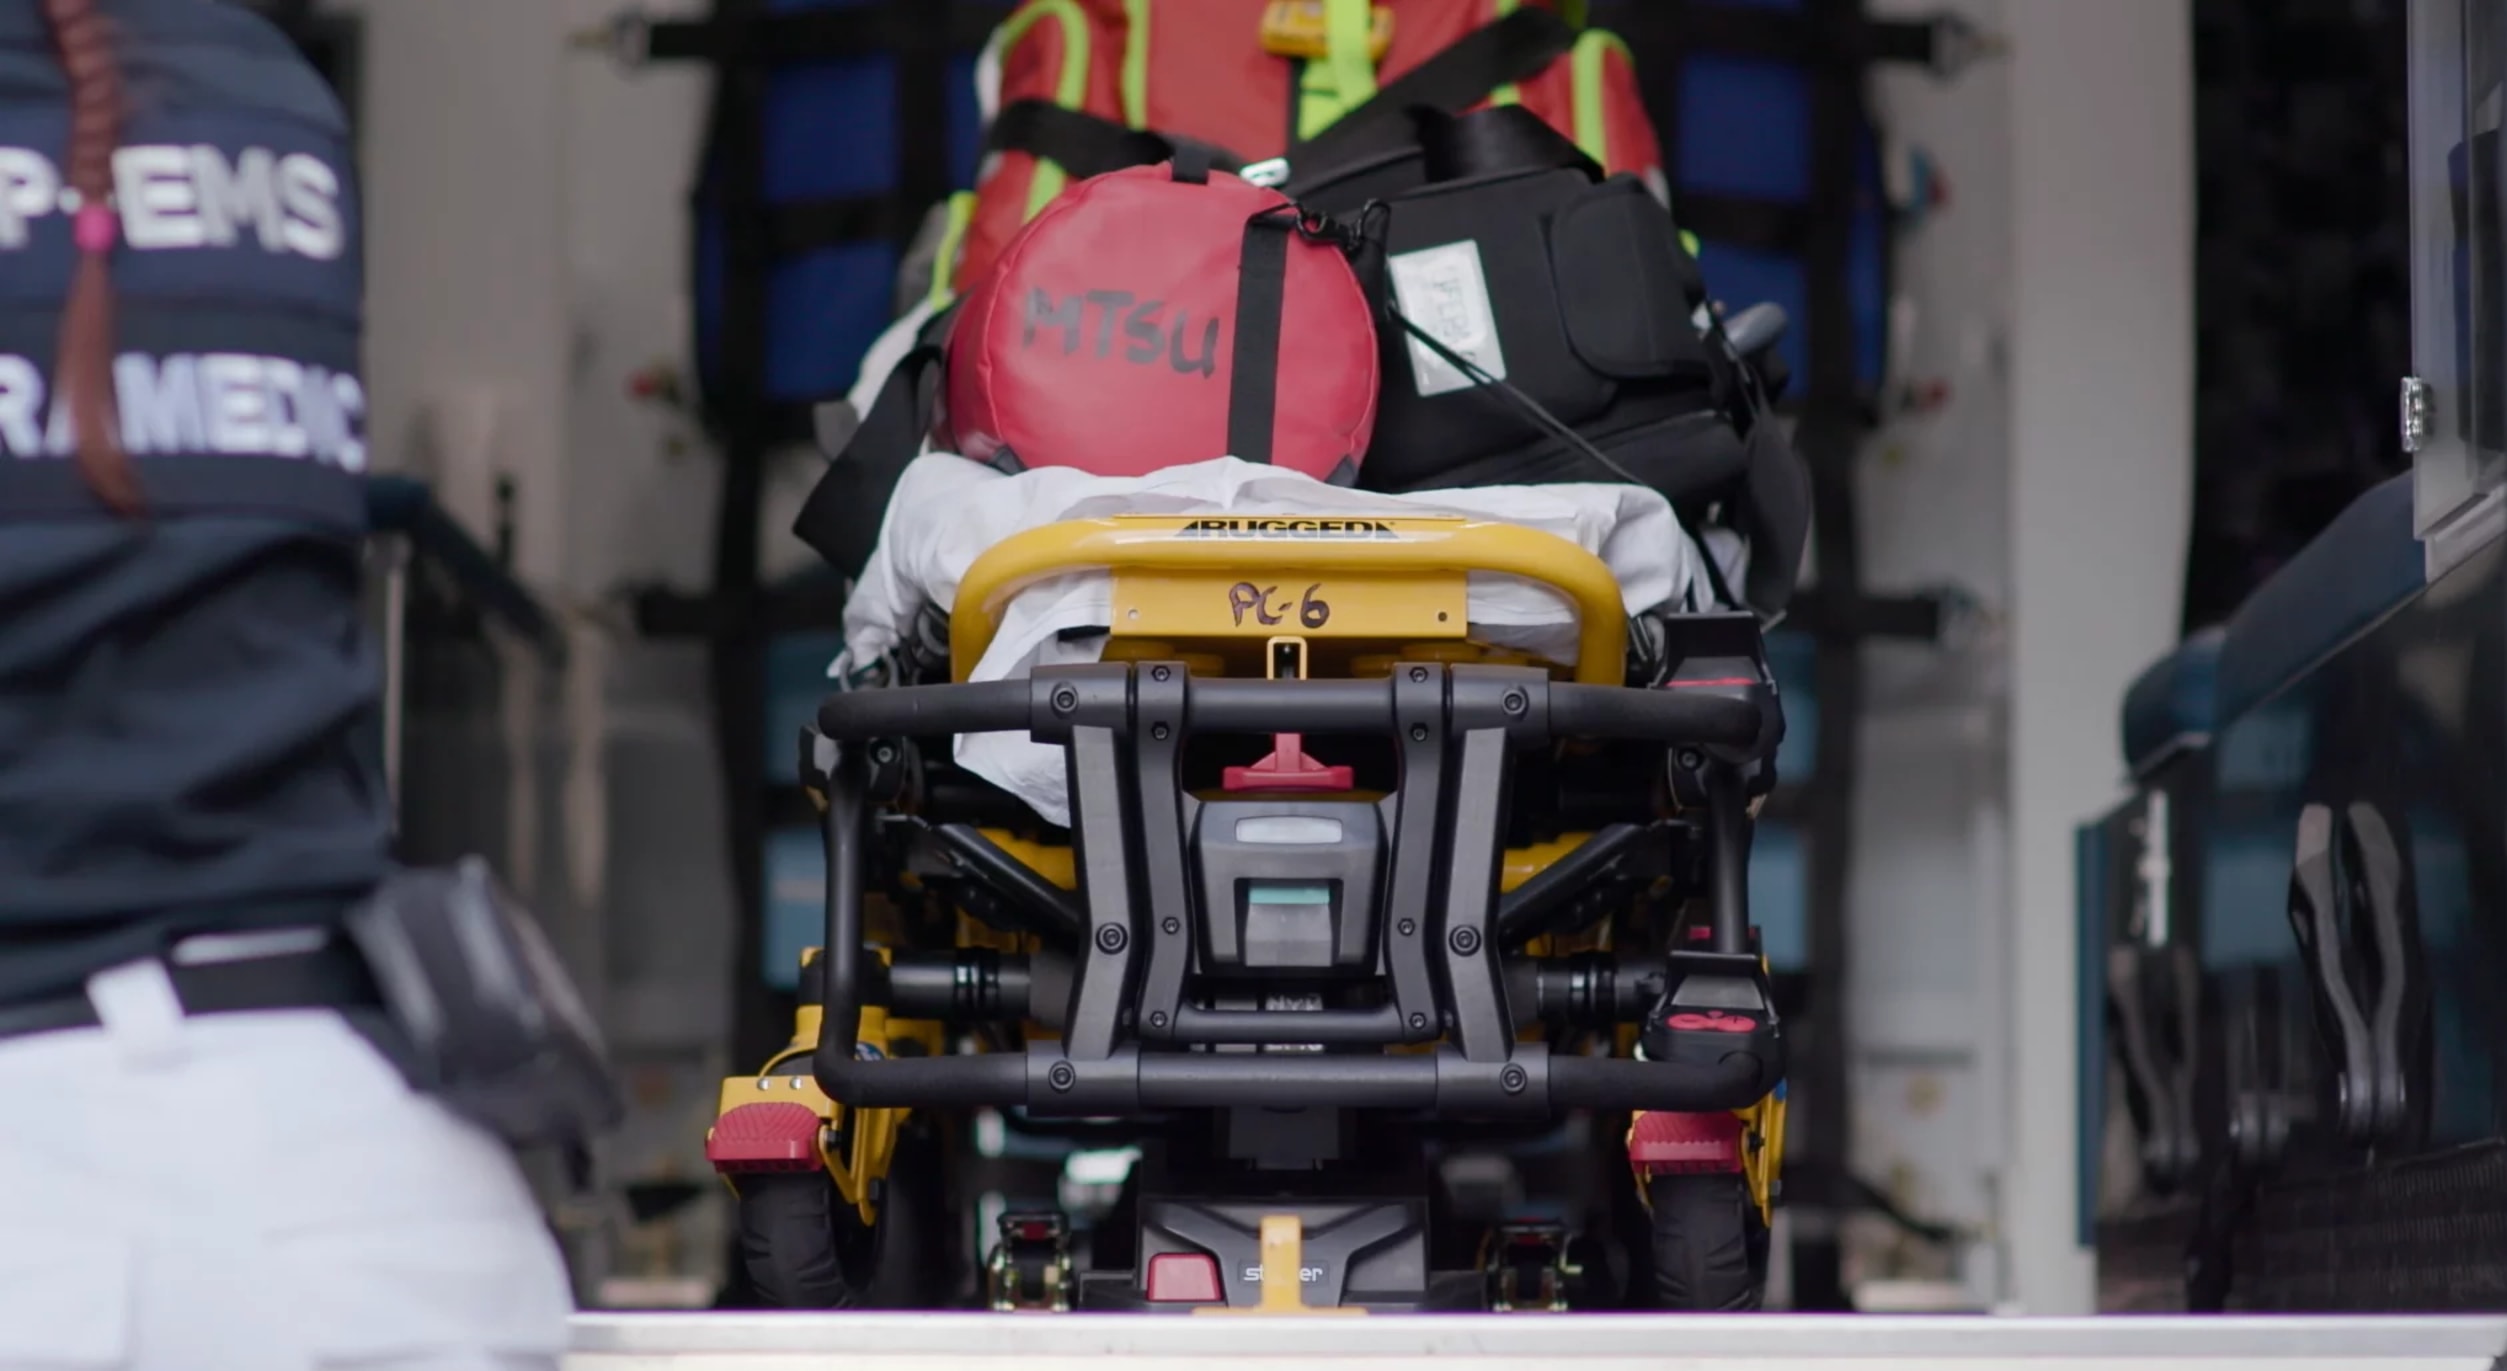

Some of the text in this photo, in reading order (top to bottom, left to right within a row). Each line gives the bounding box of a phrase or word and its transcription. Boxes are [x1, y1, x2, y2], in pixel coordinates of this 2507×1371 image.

[1022, 286, 1220, 380] MTSU
[1201, 520, 1373, 539] RUGGED
[1228, 581, 1330, 629] PC-6
[1243, 1264, 1323, 1282] ster
